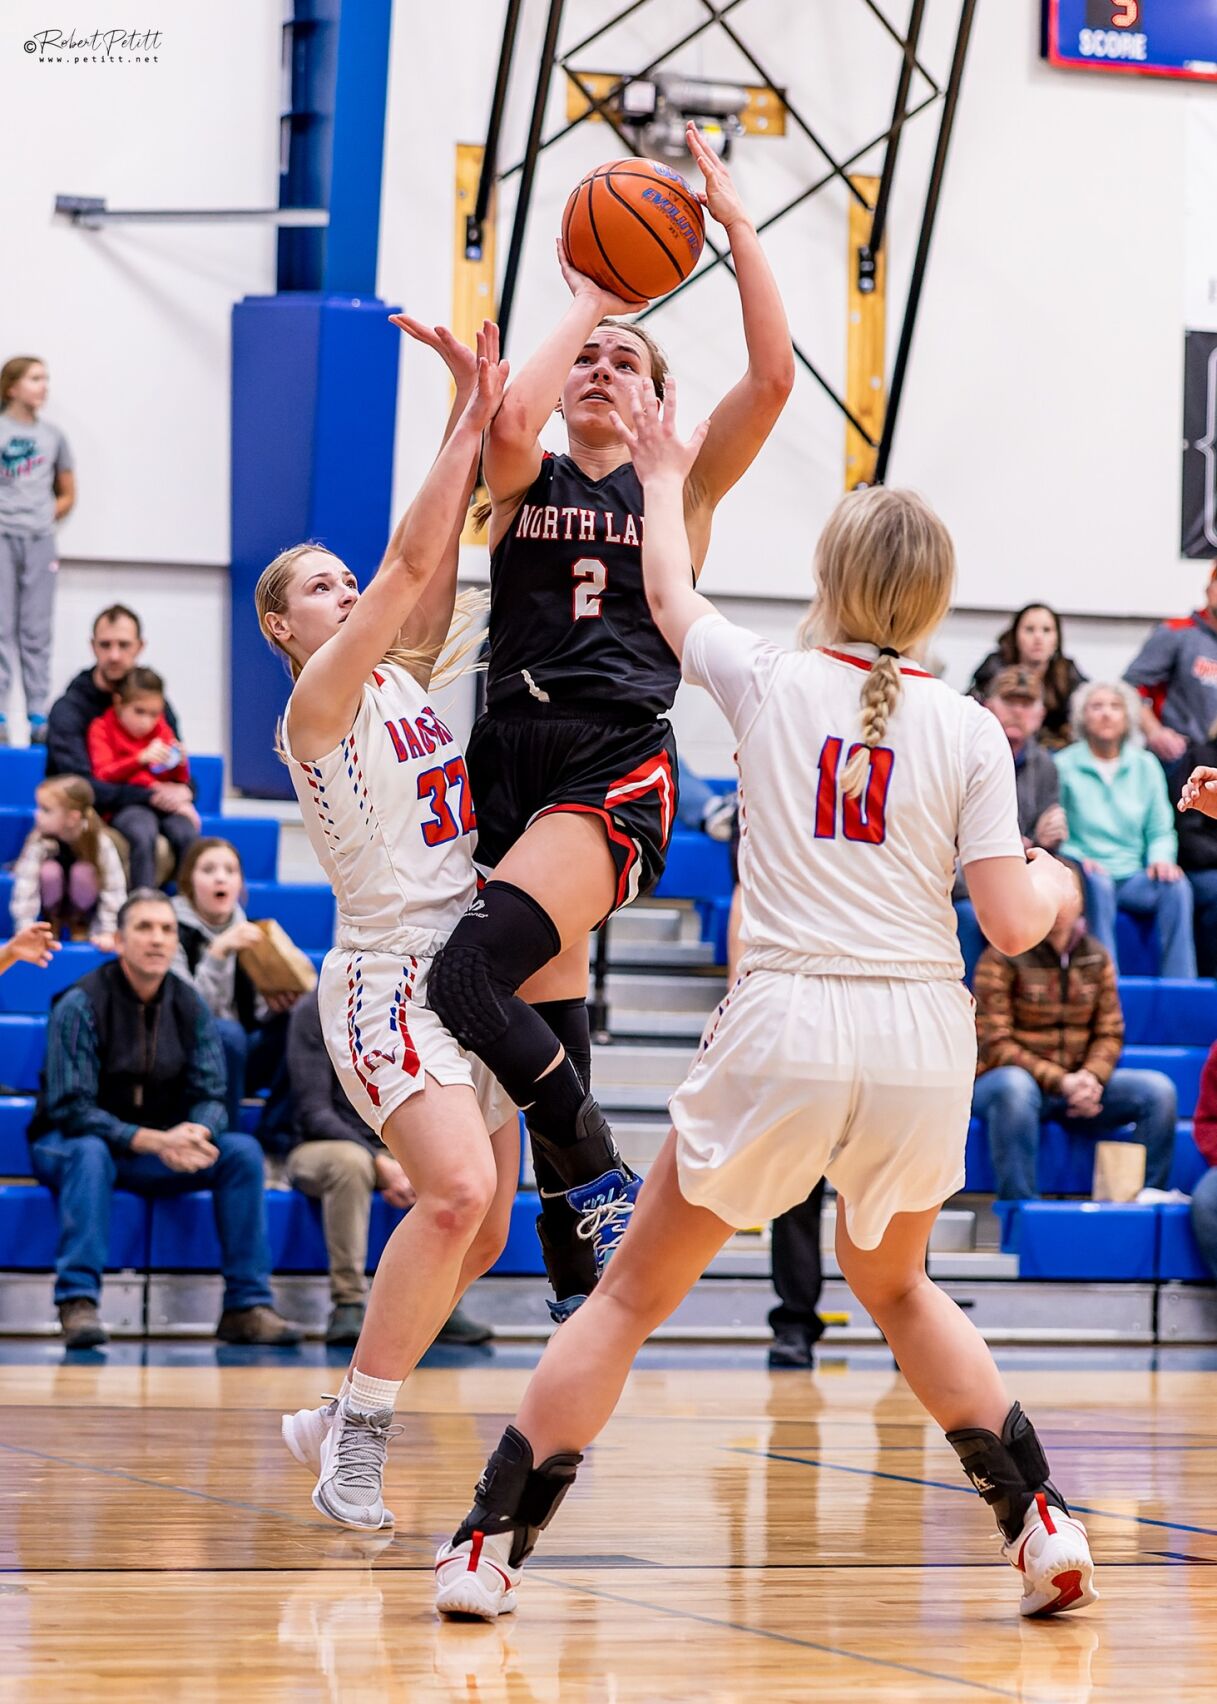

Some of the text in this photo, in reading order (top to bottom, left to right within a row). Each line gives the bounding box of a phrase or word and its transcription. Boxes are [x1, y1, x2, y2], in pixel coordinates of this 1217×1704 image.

[1078, 28, 1148, 60] SCORE
[515, 503, 646, 547] NORTH LA
[572, 556, 608, 622] 2
[813, 734, 896, 847] 10
